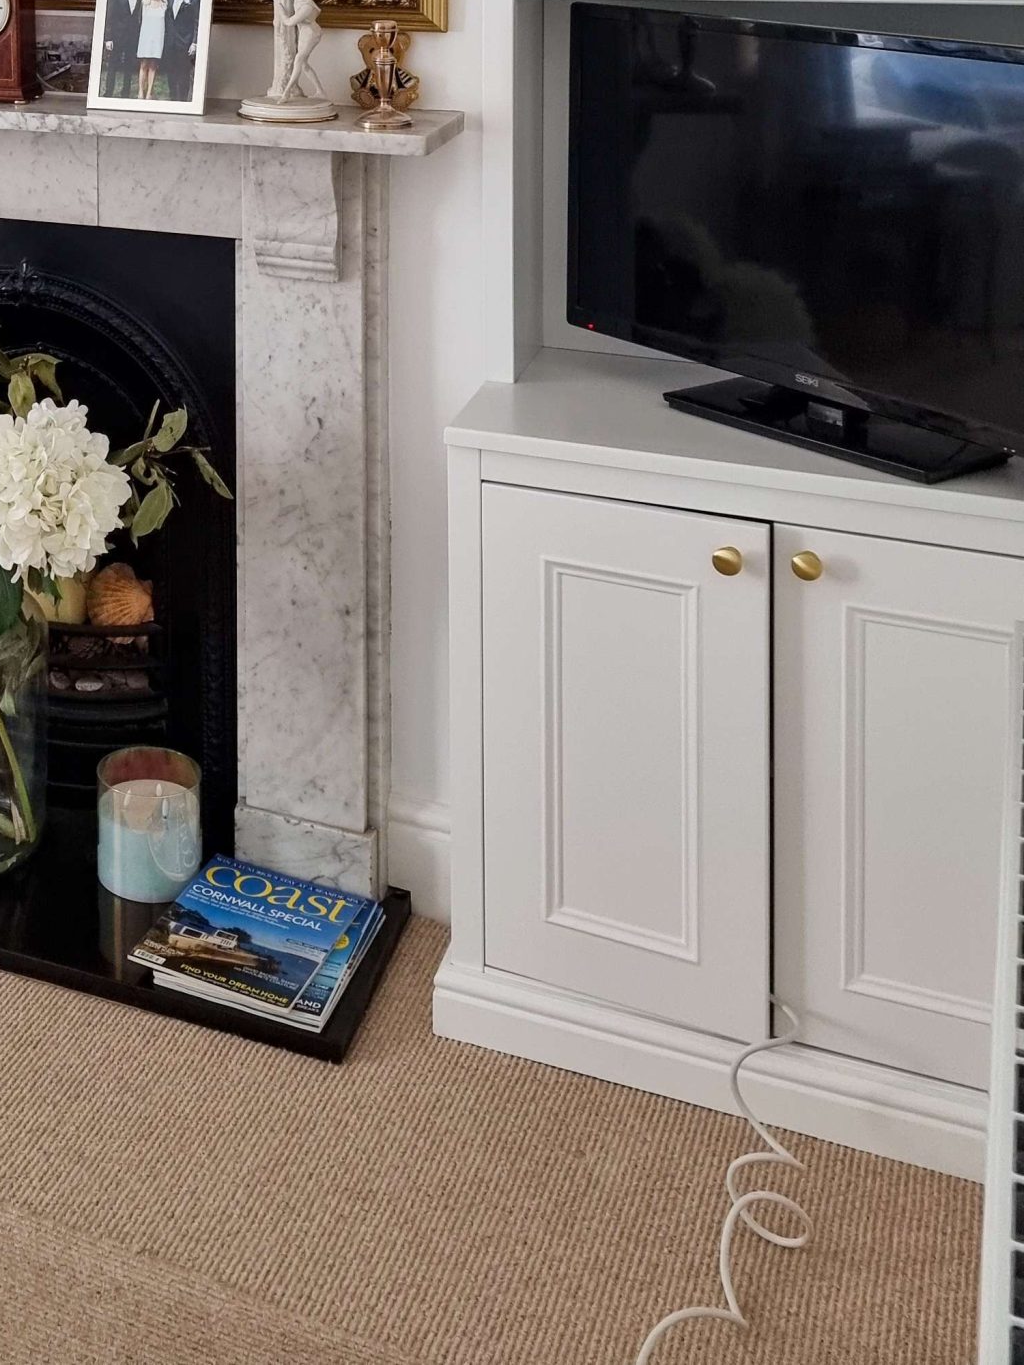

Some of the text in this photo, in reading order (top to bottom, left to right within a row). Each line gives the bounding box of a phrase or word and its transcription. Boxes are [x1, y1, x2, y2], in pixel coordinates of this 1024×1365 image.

[192, 884, 322, 931] CORNWALL SPECIAL
[205, 865, 353, 924] coast
[180, 964, 289, 1004] FIND YOUR DREAM HOME
